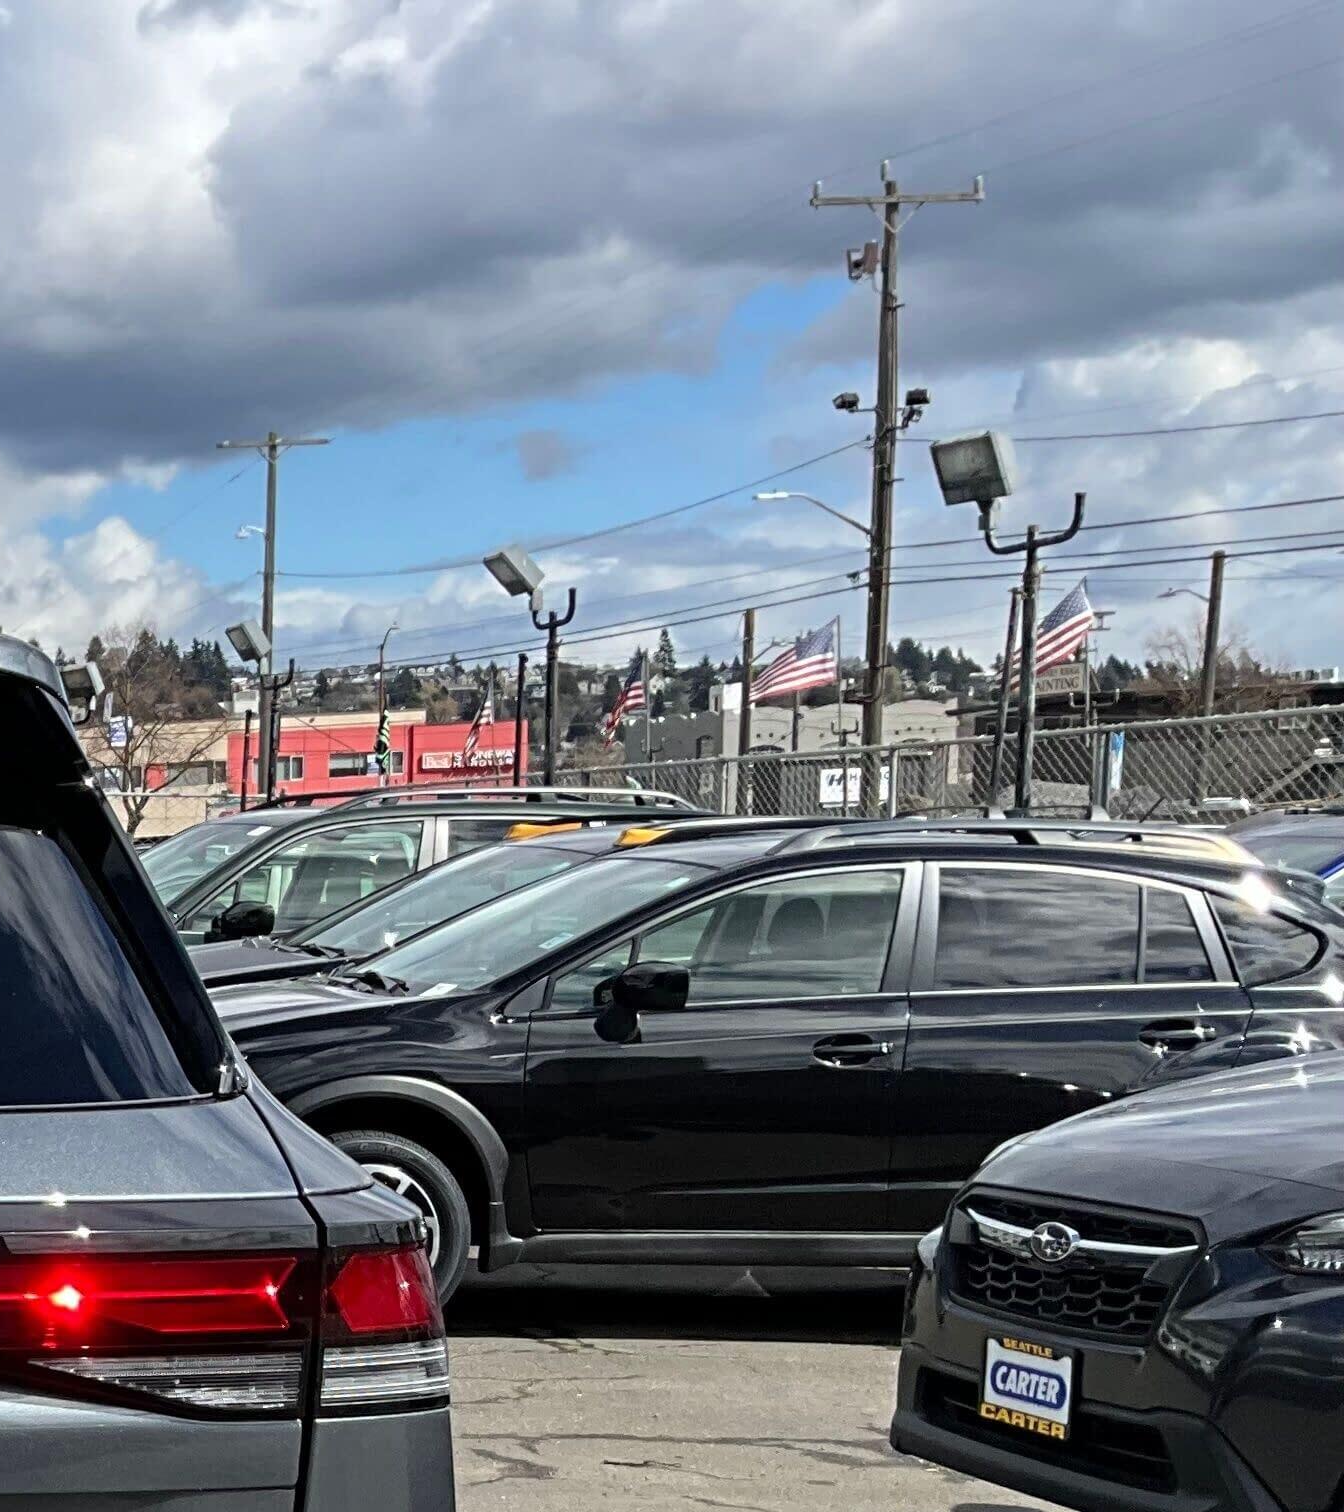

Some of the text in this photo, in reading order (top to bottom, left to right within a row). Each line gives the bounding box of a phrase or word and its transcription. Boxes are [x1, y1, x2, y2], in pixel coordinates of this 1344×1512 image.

[1036, 677, 1079, 692] AINTING
[1002, 1337, 1053, 1358] SEATTLE
[995, 1365, 1060, 1405] CARTER
[981, 1402, 1066, 1440] CARTER
